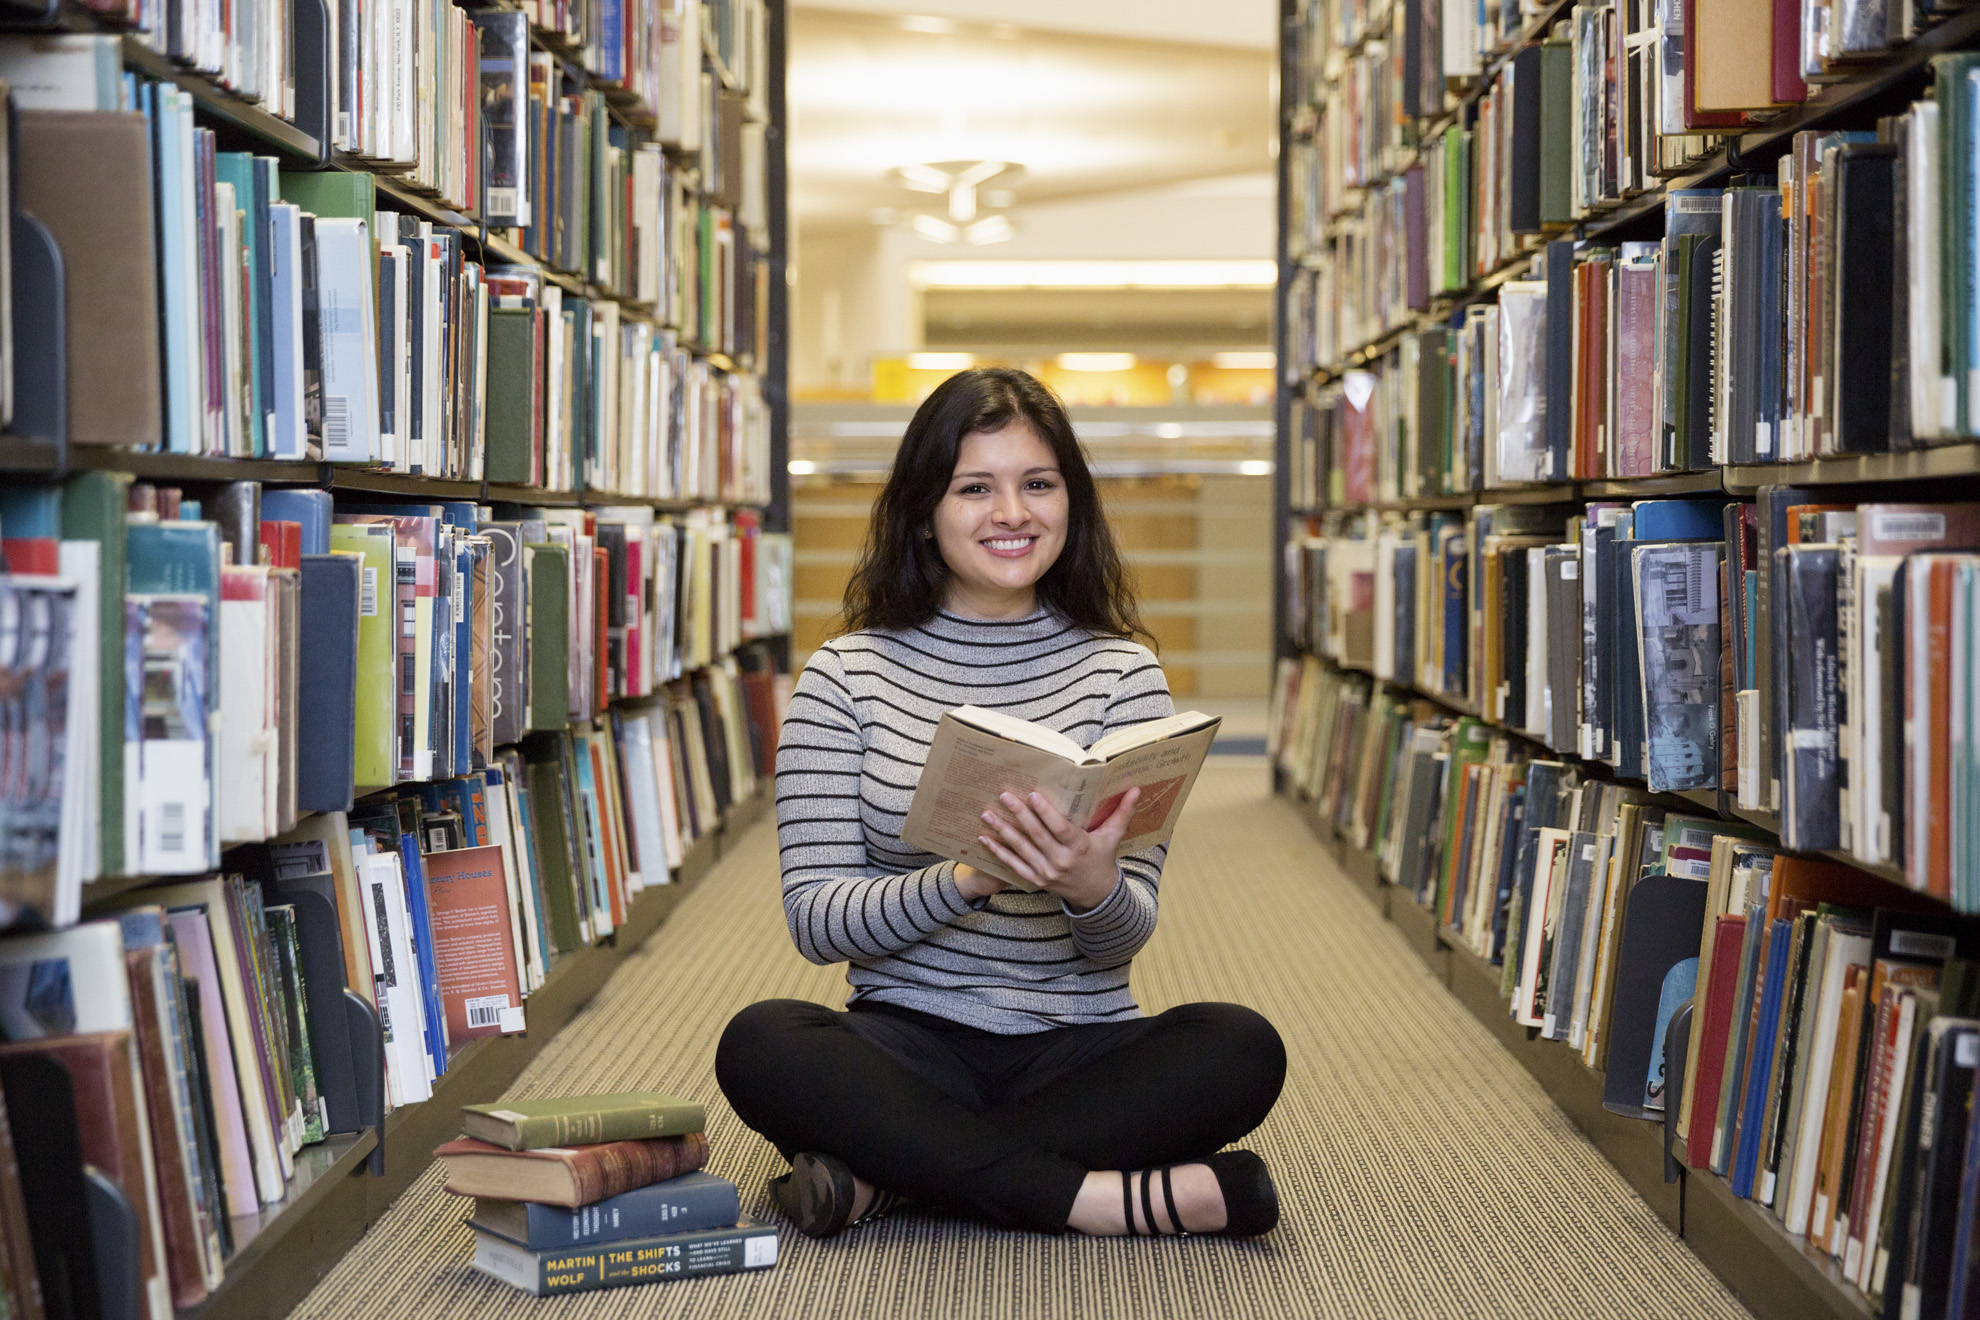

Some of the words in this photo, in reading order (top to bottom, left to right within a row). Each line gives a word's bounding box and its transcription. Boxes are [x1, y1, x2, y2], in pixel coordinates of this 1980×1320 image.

[1708, 731, 1716, 749] Gehry
[1161, 747, 1180, 758] and
[457, 870, 493, 880] Houses
[547, 1256, 595, 1272] MARTIN
[609, 1250, 633, 1263] THE
[638, 1245, 681, 1261] SHIFTS
[631, 1262, 681, 1277] SHOCKS
[547, 1273, 584, 1287] WOLF
